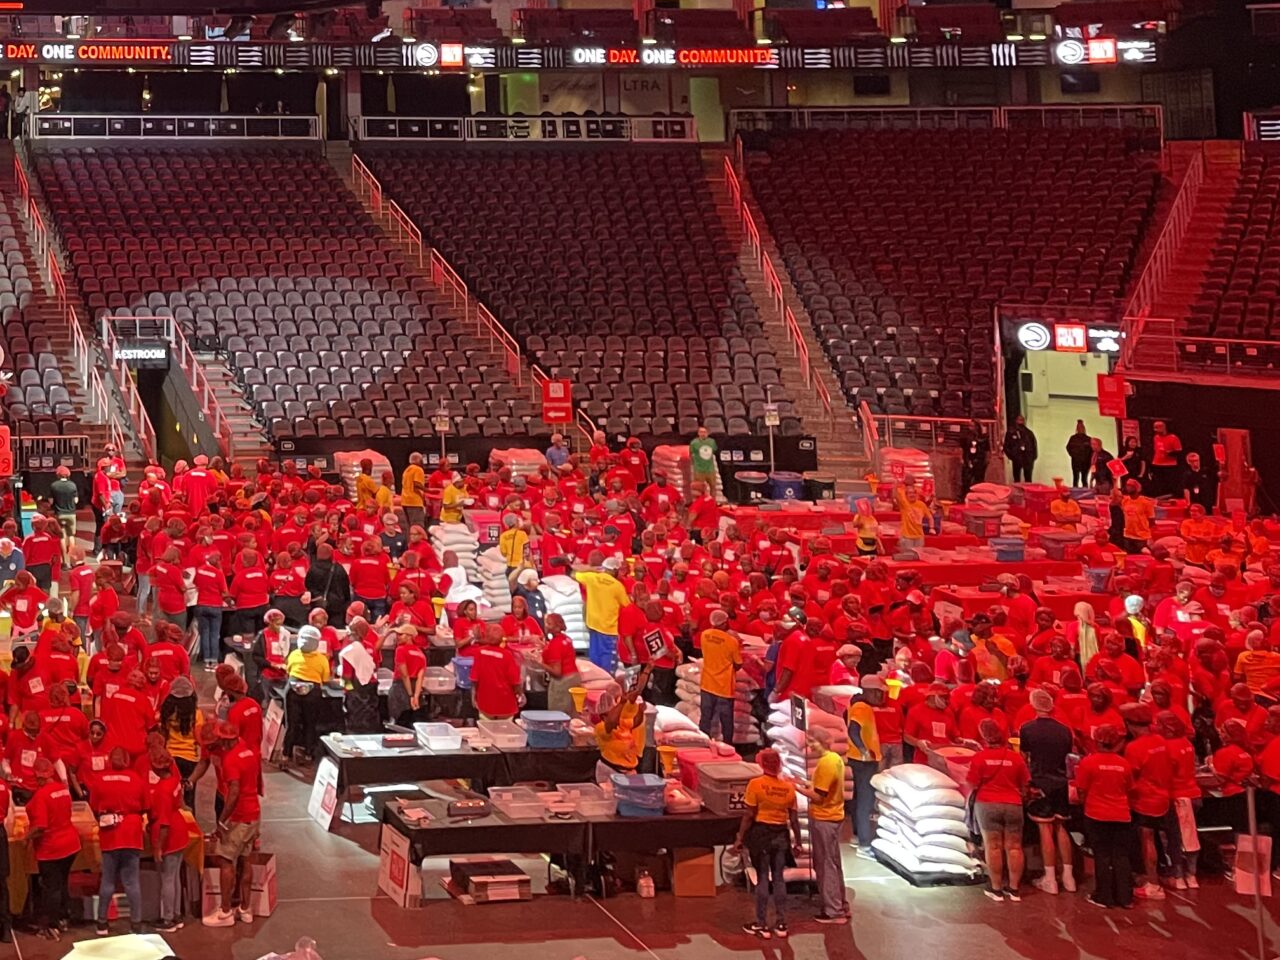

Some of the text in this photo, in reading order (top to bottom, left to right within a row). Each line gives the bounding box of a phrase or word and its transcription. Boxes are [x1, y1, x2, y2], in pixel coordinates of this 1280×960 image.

[7, 44, 38, 58] DAY.
[42, 45, 74, 59] ONE
[78, 44, 171, 60] COMMUNITY.
[574, 47, 606, 63] ONE
[609, 48, 640, 63] DAY.
[642, 48, 676, 64] ONE
[115, 349, 166, 359] RESTROOM
